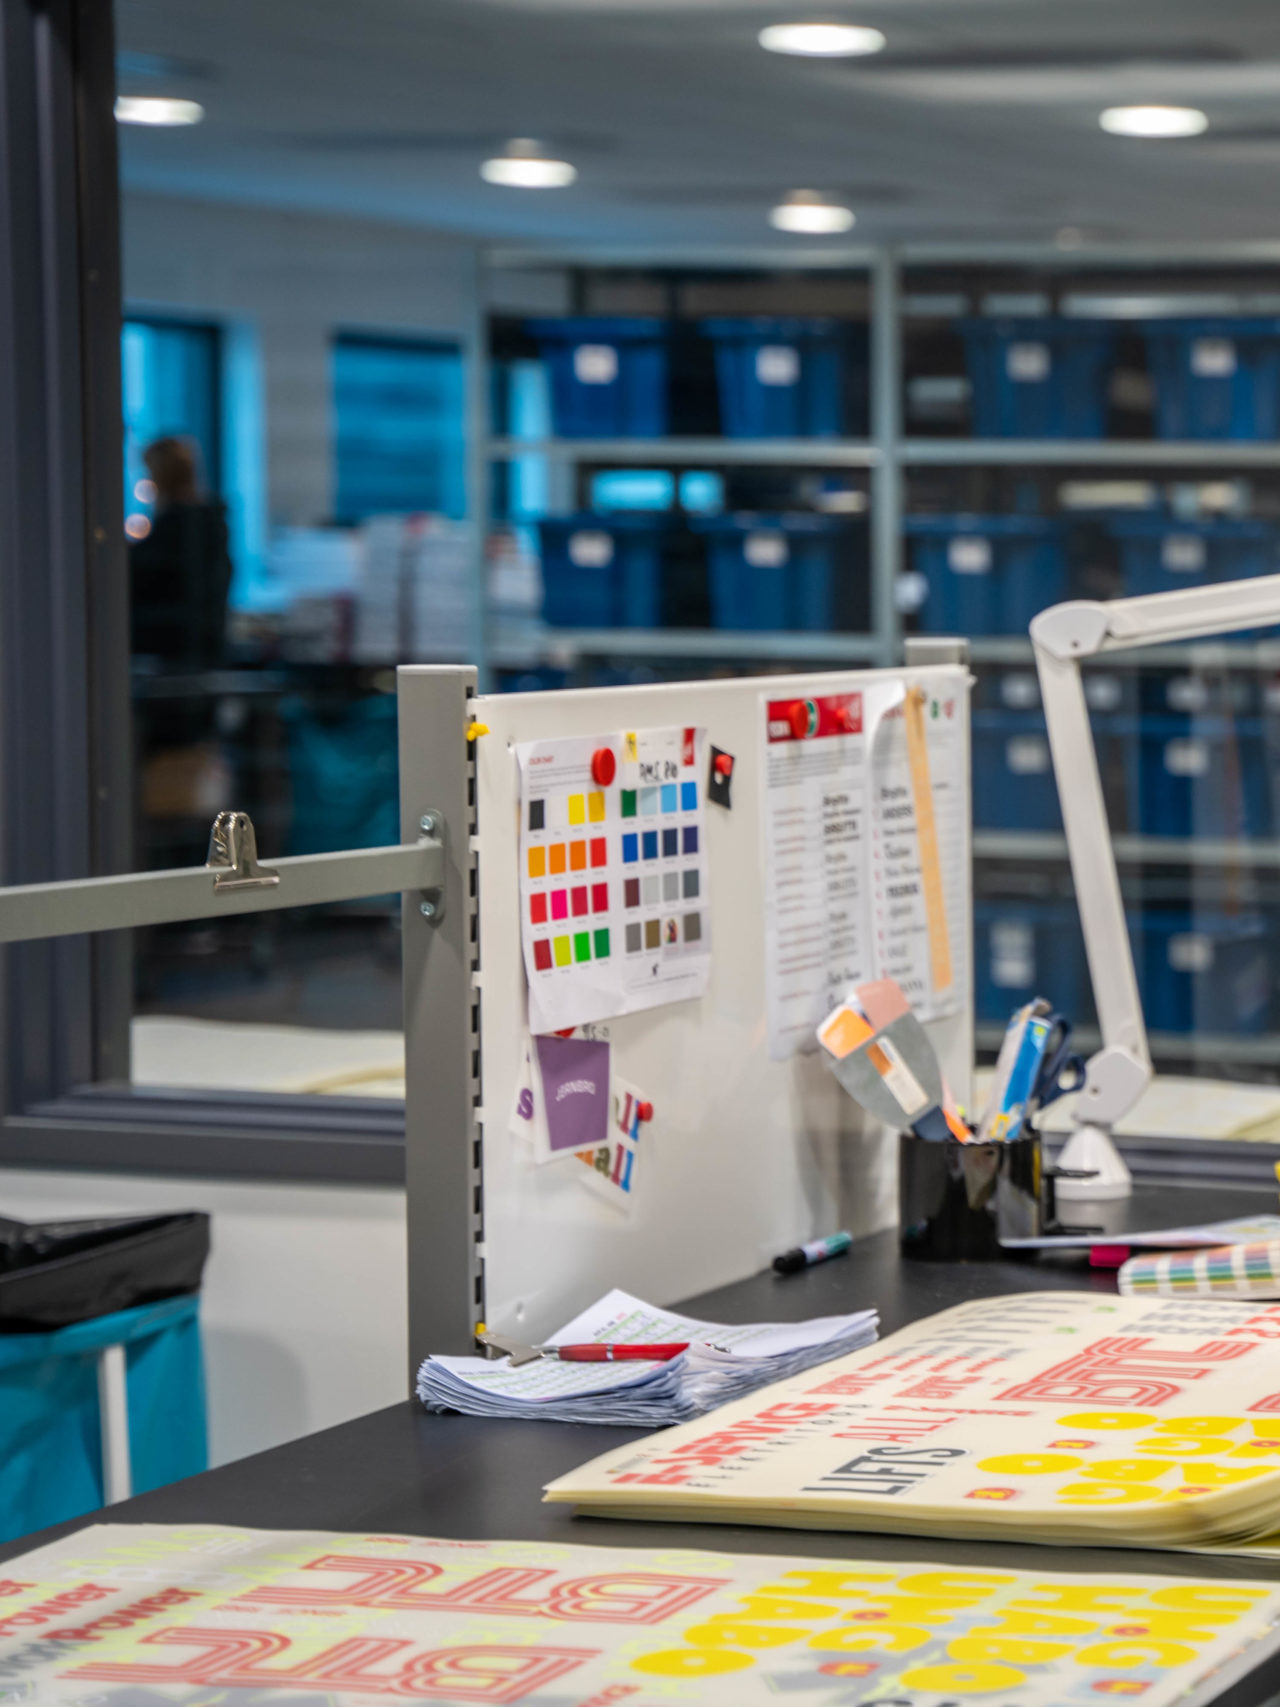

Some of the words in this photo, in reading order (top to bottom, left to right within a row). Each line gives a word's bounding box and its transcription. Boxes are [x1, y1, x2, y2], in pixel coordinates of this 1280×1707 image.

[800, 1372, 896, 1396] BTC
[891, 1375, 984, 1400] BTC
[992, 1336, 1263, 1407] BTC
[830, 1416, 960, 1444] ALL
[800, 1446, 968, 1496] LIFTS
[228, 1554, 736, 1625] BTC
[629, 1570, 899, 1678] HABO
[53, 1626, 604, 1705] BTC
[899, 1583, 1151, 1695] HABO
